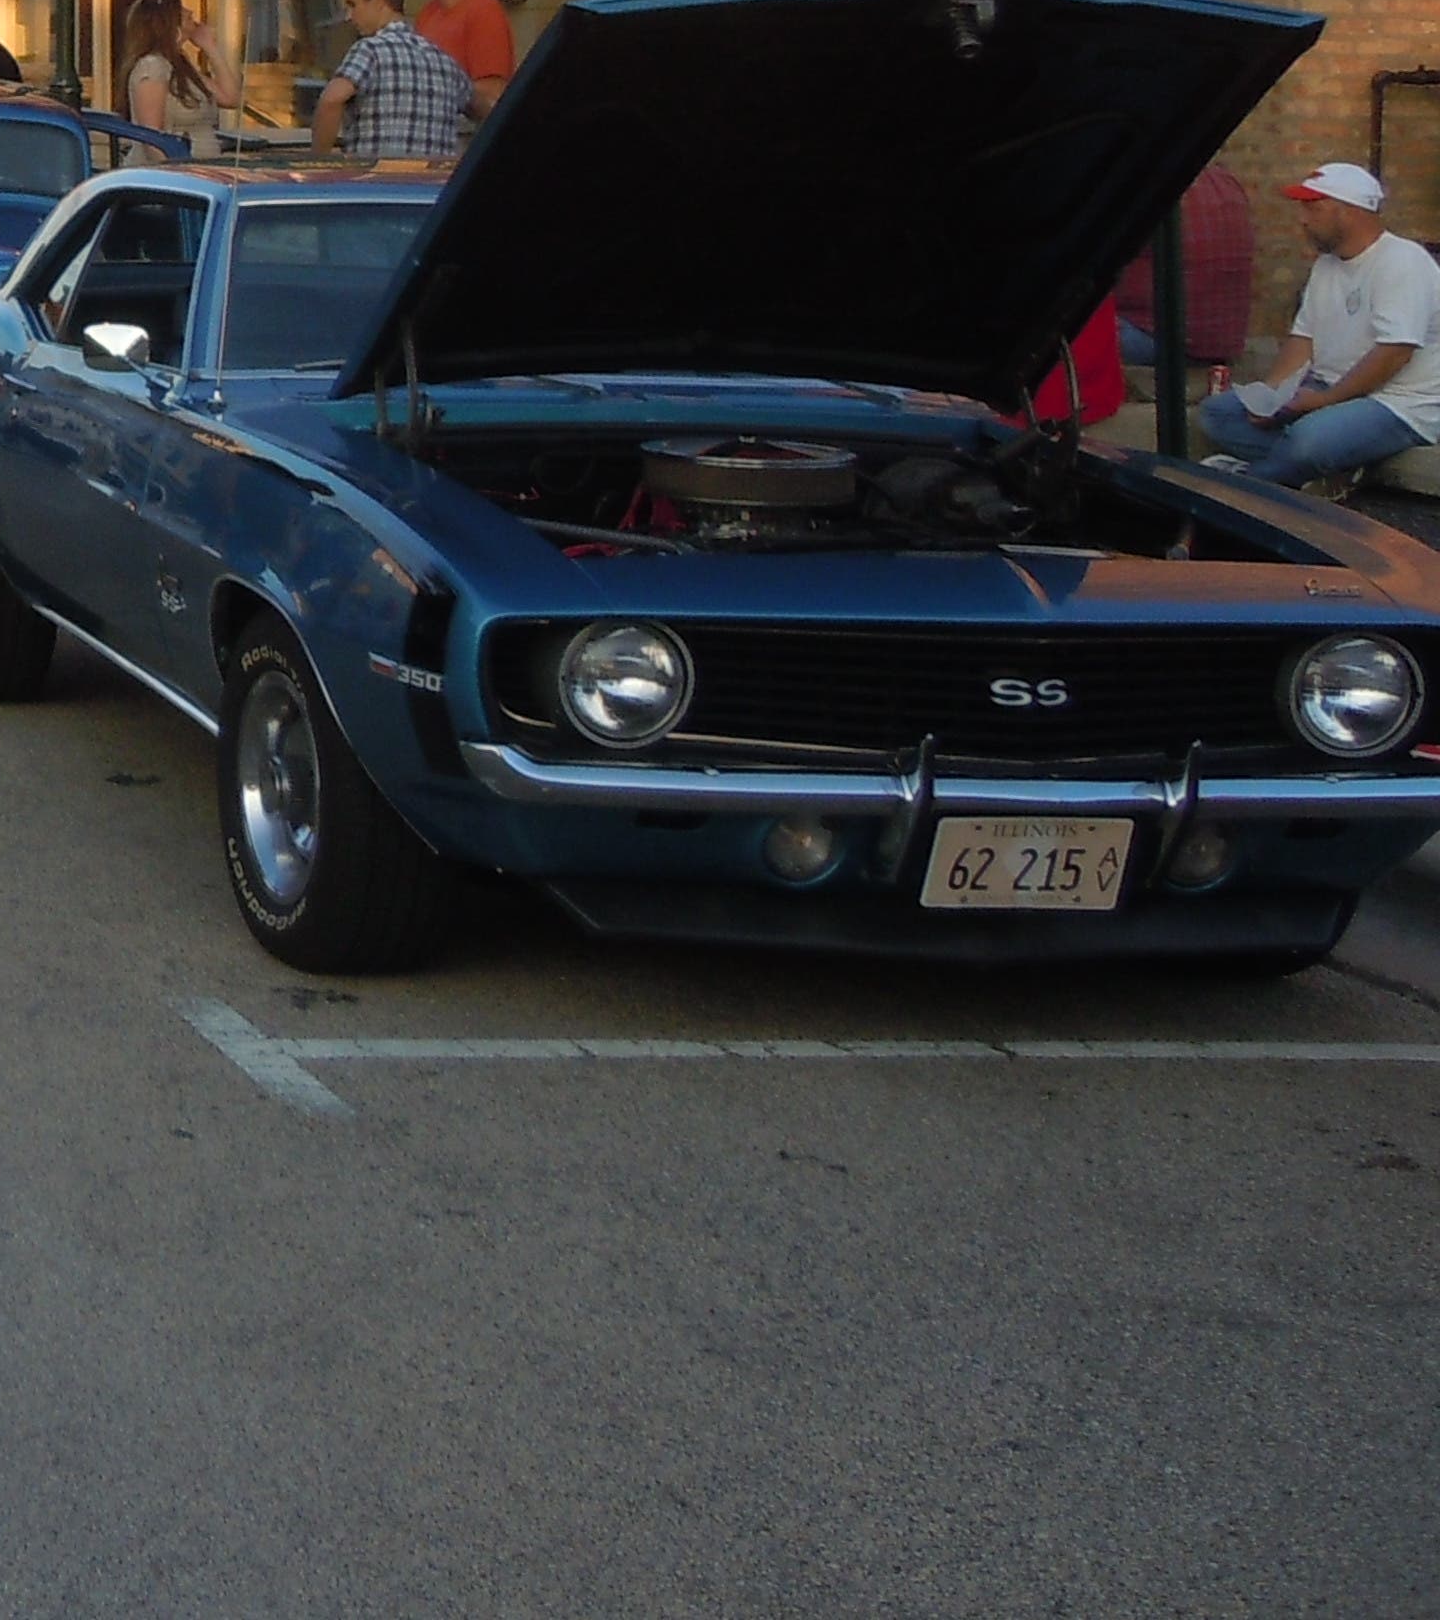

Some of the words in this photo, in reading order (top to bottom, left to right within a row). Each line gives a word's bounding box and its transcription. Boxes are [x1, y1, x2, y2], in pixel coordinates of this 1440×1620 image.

[398, 664, 442, 693] 350
[990, 678, 1068, 706] SS
[993, 824, 1078, 838] ILLINOIS
[948, 847, 996, 891] 62
[1012, 847, 1087, 892] 215
